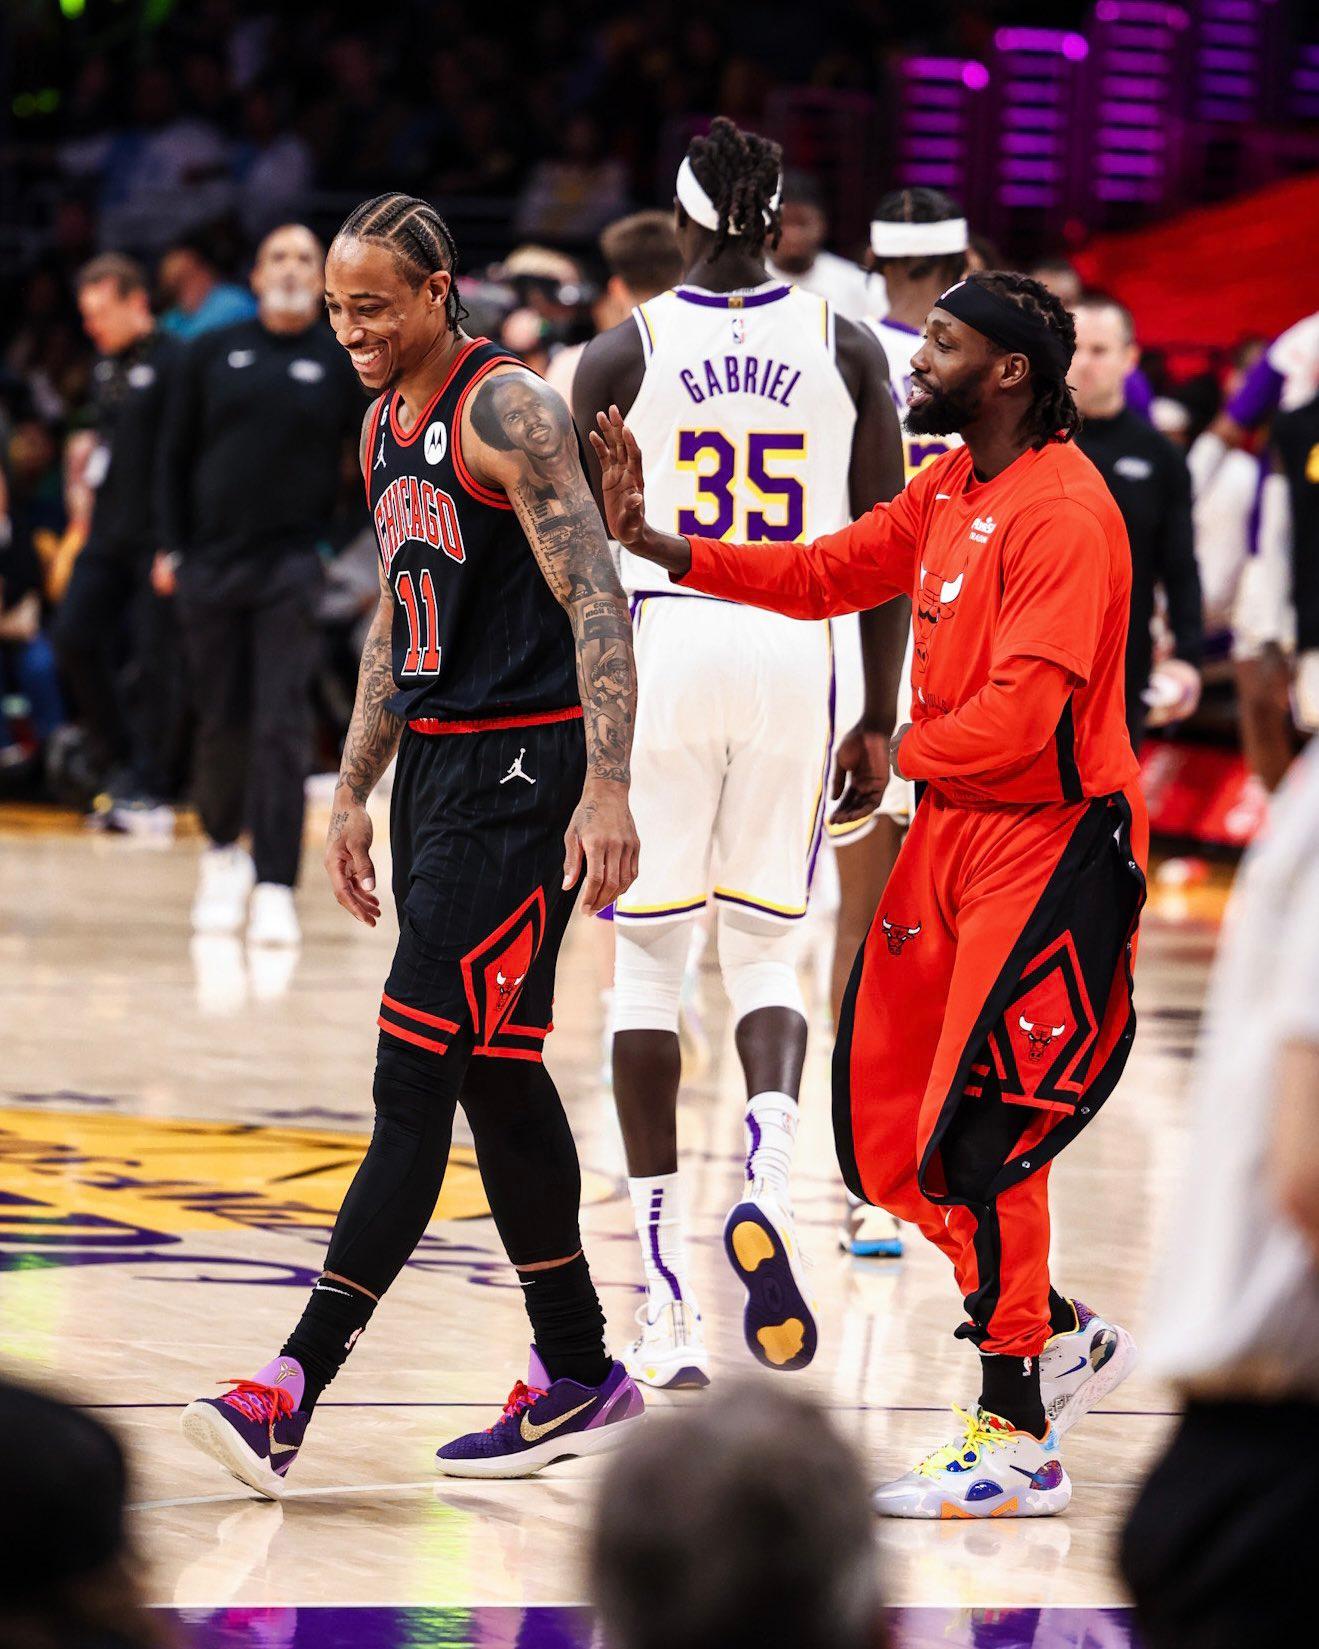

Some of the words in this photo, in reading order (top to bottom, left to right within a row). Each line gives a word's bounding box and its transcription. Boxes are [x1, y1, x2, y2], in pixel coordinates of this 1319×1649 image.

[679, 355, 802, 407] GABRIEL
[373, 475, 467, 579] CHICAGO
[675, 426, 808, 543] 35
[394, 568, 442, 676] 11
